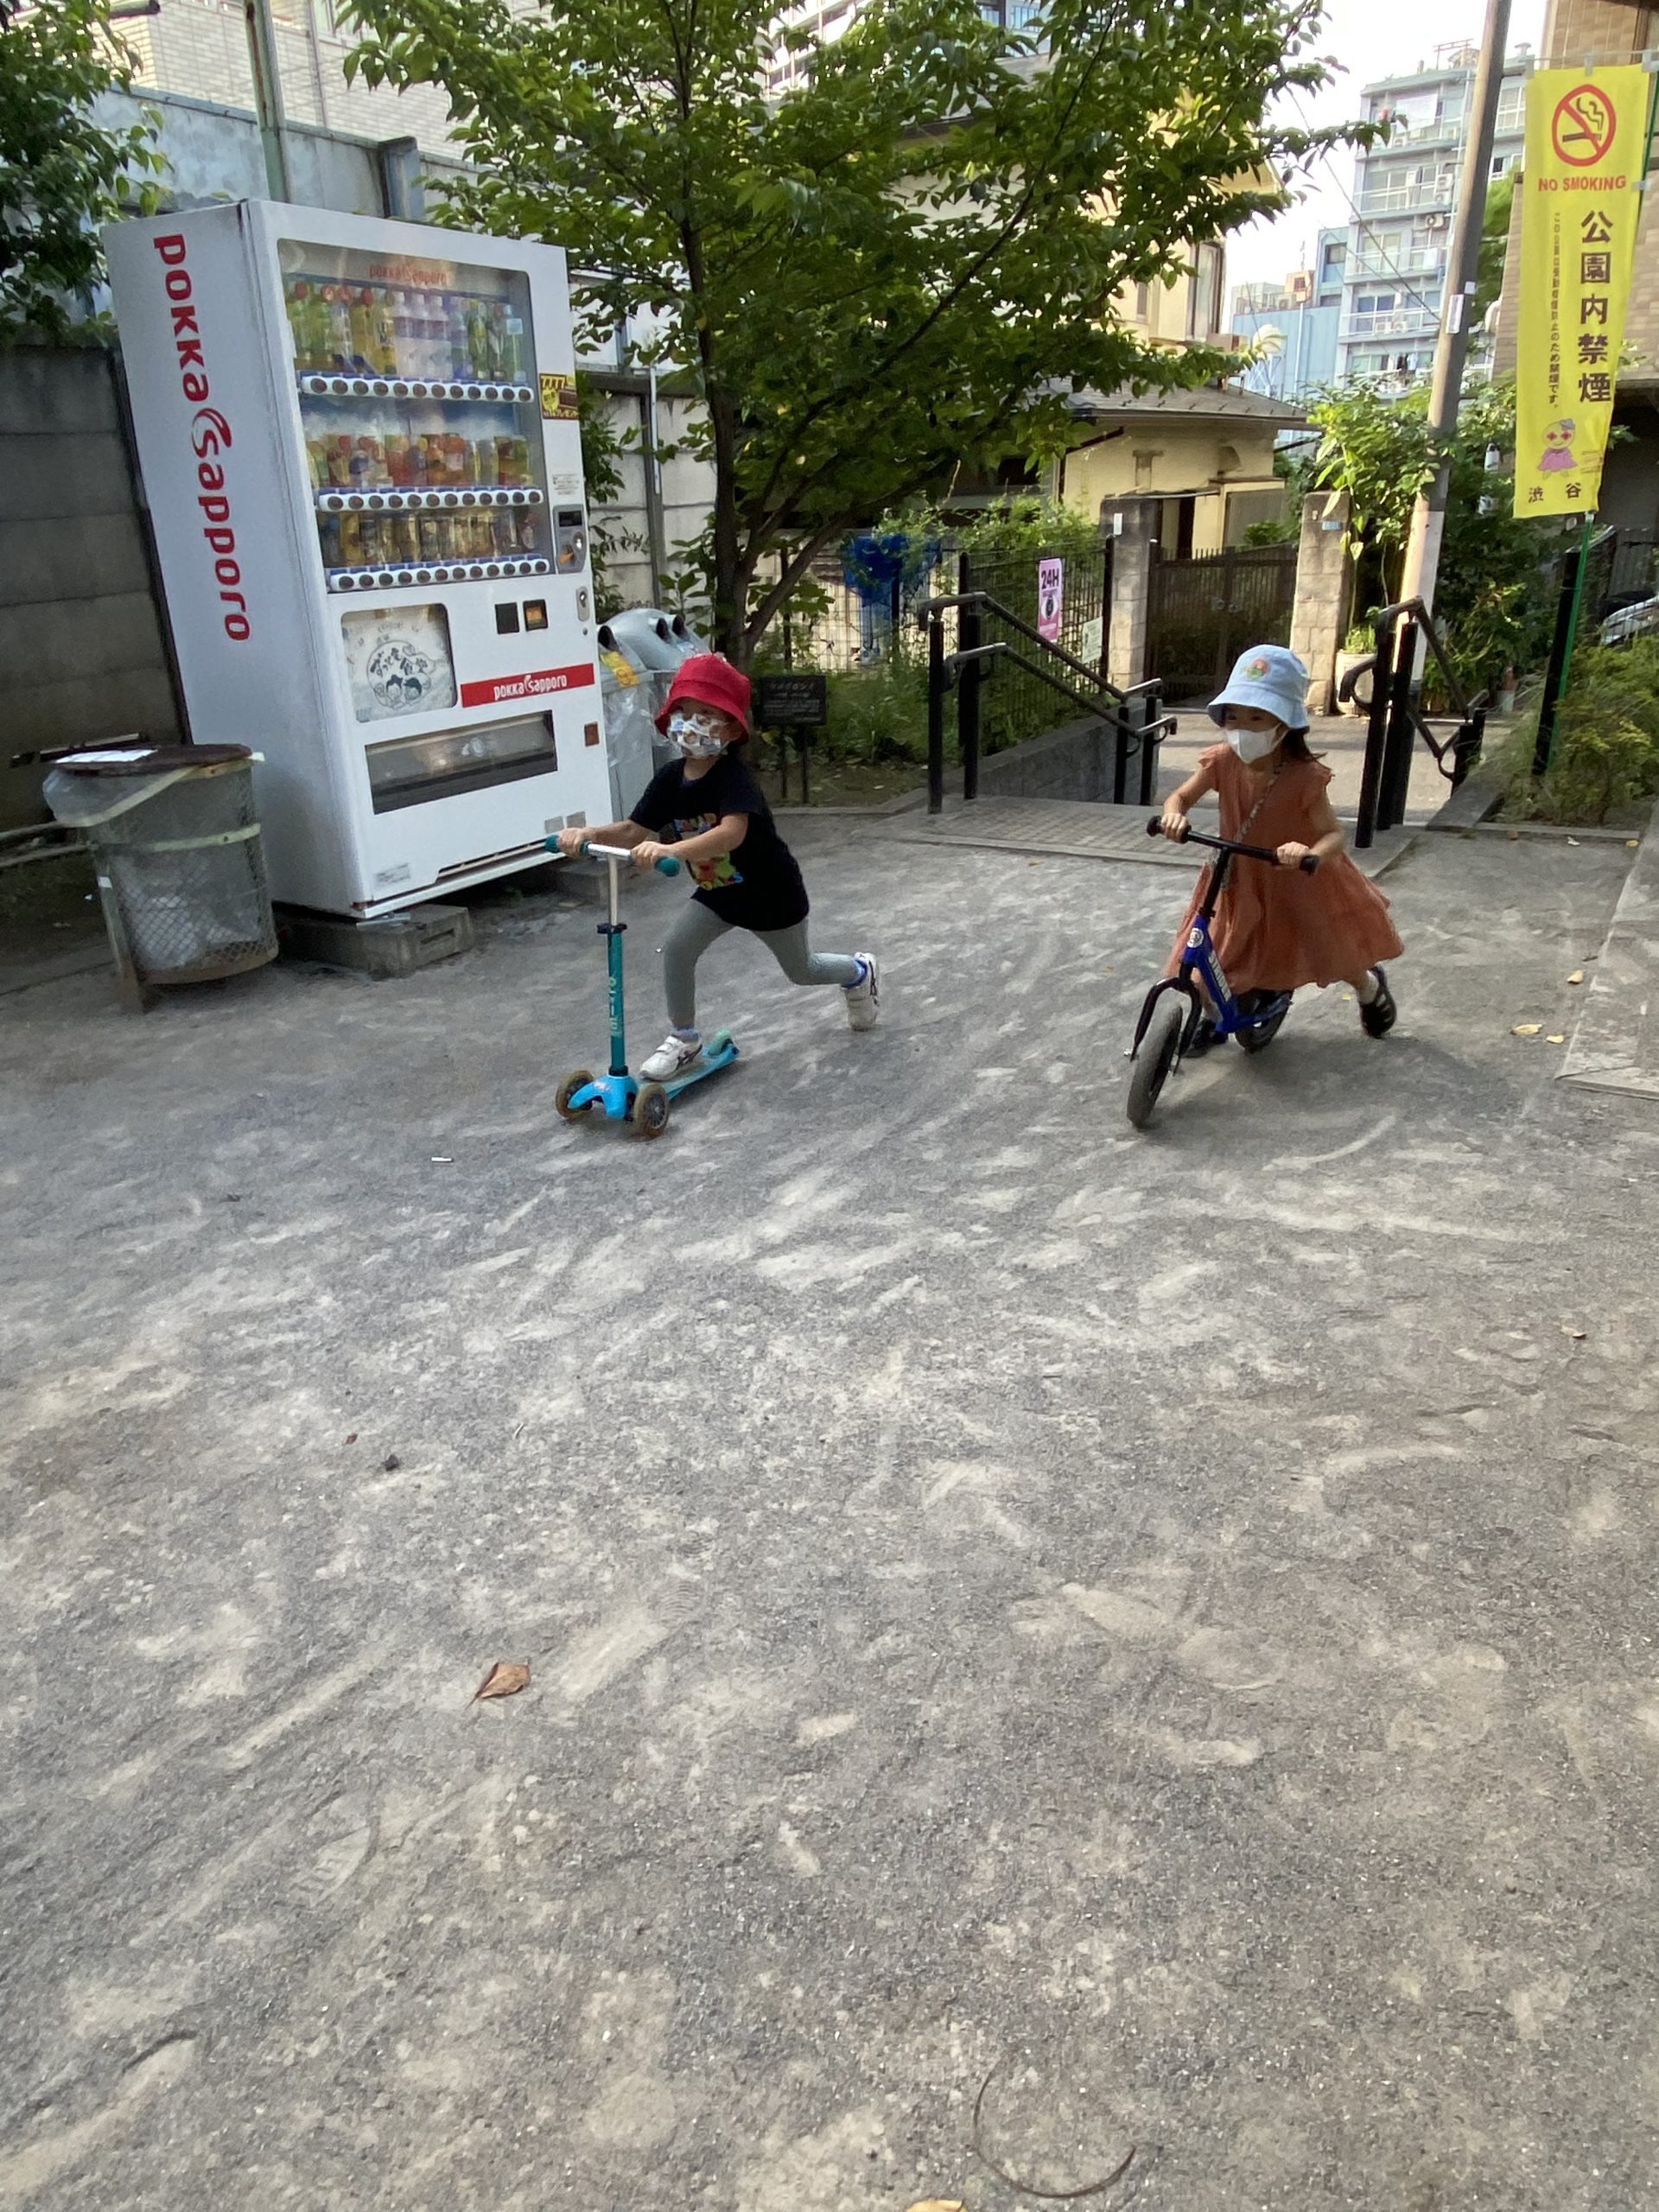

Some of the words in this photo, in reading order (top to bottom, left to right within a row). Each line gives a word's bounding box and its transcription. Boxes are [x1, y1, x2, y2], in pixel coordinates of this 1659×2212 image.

[1538, 177, 1558, 192] NO
[1562, 175, 1627, 192] SMOKING
[1578, 210, 1614, 403] 公園内禁煙
[1040, 568, 1060, 590] 24H
